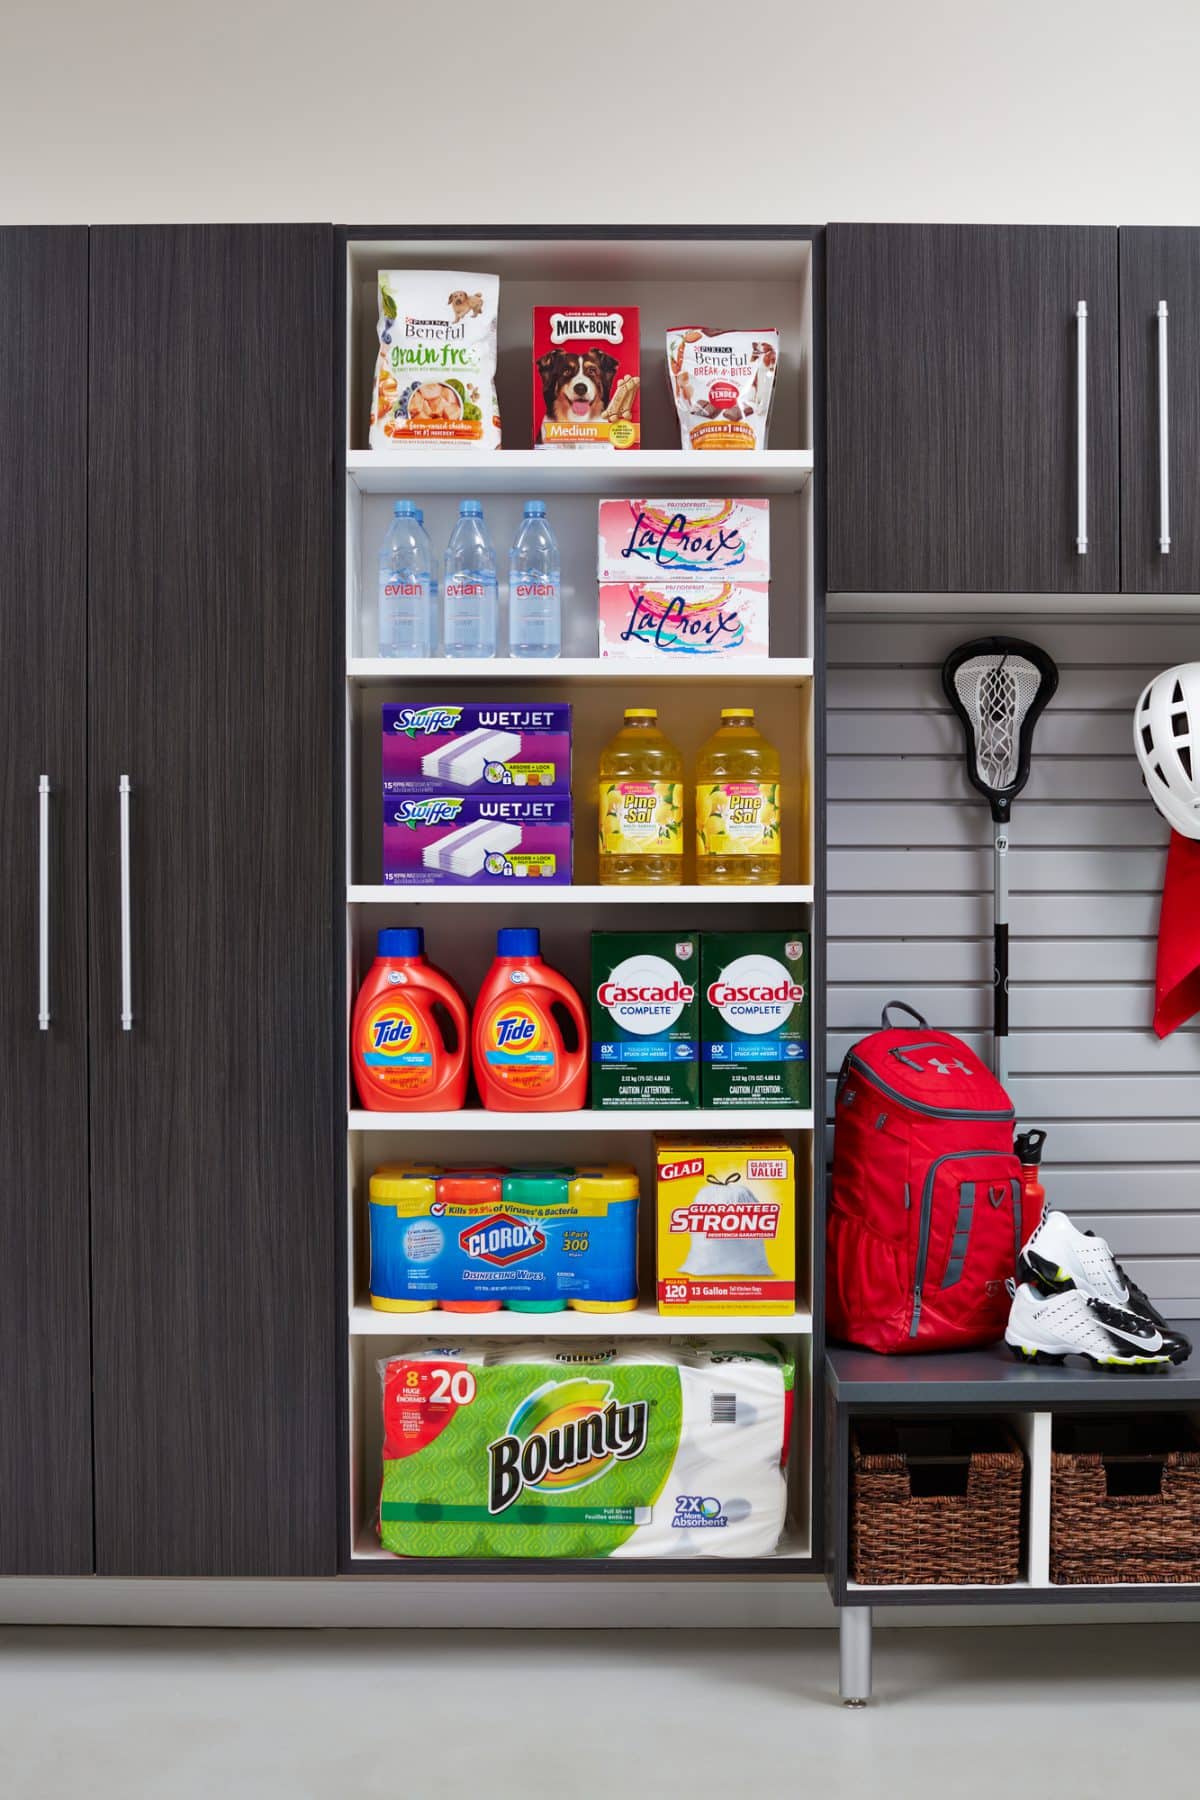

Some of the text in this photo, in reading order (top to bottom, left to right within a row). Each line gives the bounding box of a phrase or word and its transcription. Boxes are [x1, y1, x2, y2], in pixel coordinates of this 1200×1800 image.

[405, 324, 465, 340] Beneful
[557, 320, 617, 336] MILK-BONE
[391, 344, 440, 367] grain
[695, 352, 748, 367] Beneful
[550, 425, 598, 437] Medium
[384, 583, 423, 597] evian
[446, 582, 484, 597] evian
[516, 583, 554, 597] evian
[394, 709, 460, 733] Swiffer
[624, 793, 657, 809] Pine
[729, 794, 761, 810] Pine
[395, 800, 461, 825] Swiffer
[598, 980, 694, 1007] Cascade
[708, 980, 803, 1006] Cascade
[620, 1006, 671, 1015] COMPLETE
[730, 1006, 781, 1015] COMPLETE
[374, 1020, 413, 1048] Tide
[497, 1018, 536, 1047] Tide
[601, 1045, 614, 1053] 8X
[711, 1044, 724, 1053] 8X
[619, 1086, 640, 1094] CAUTION
[729, 1085, 750, 1094] CAUTION
[661, 1162, 703, 1180] GLAD
[751, 1167, 783, 1177] VALUE
[448, 1207, 466, 1215] Kills
[469, 1206, 492, 1215] 99.9%
[544, 1207, 578, 1216] Bacteria
[690, 1204, 780, 1213] GUARANTEED
[671, 1210, 777, 1231] STRONG
[468, 1224, 539, 1257] CLOROX
[562, 1239, 589, 1251] 300
[665, 1285, 687, 1298] 120
[691, 1287, 700, 1296] 13
[703, 1287, 728, 1296] Gallon
[406, 1370, 419, 1387] 8
[429, 1369, 477, 1405] 20
[489, 1400, 648, 1513] Bounty
[676, 1496, 700, 1513] 2X
[673, 1517, 726, 1527] Absorbent
